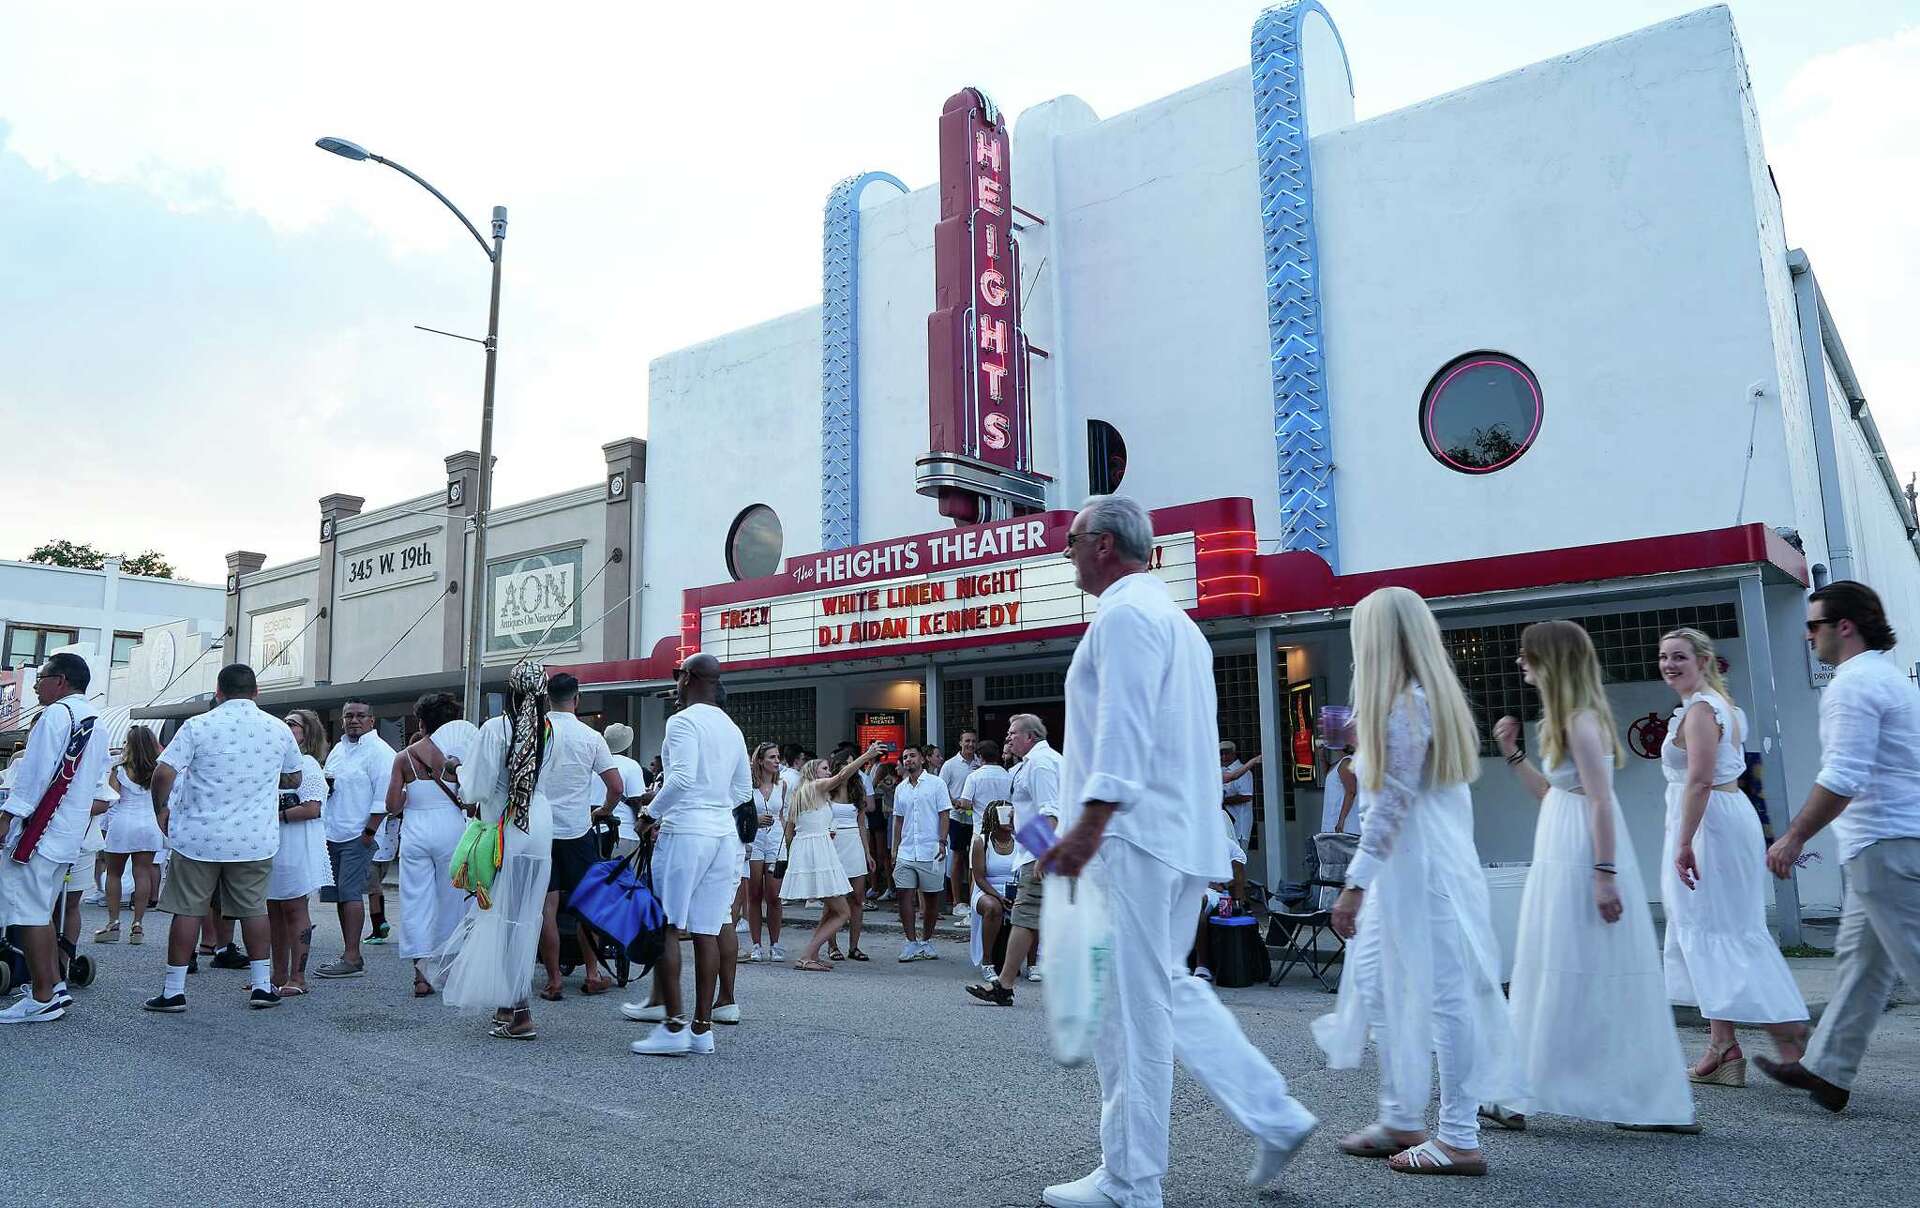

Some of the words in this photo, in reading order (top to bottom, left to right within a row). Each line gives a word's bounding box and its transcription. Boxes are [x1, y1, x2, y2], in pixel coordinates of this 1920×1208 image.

[976, 131, 1011, 449] HEIGHTS
[349, 558, 373, 582] 345
[379, 552, 394, 575] W.
[400, 542, 431, 570] 19th
[793, 565, 815, 584] The
[815, 541, 920, 584] HEIGHTS
[927, 520, 1047, 565] THEATER
[500, 571, 567, 618] AON
[821, 588, 880, 617] WHITE
[887, 581, 945, 609] LINEN
[956, 568, 1019, 599] NIGHT
[499, 617, 524, 631] Antiques
[720, 606, 771, 630] FREE!!
[818, 624, 843, 648] DJ
[848, 617, 908, 644] AIDAN
[919, 601, 1021, 636] KENNEDY
[1814, 672, 1837, 680] DRIVE
